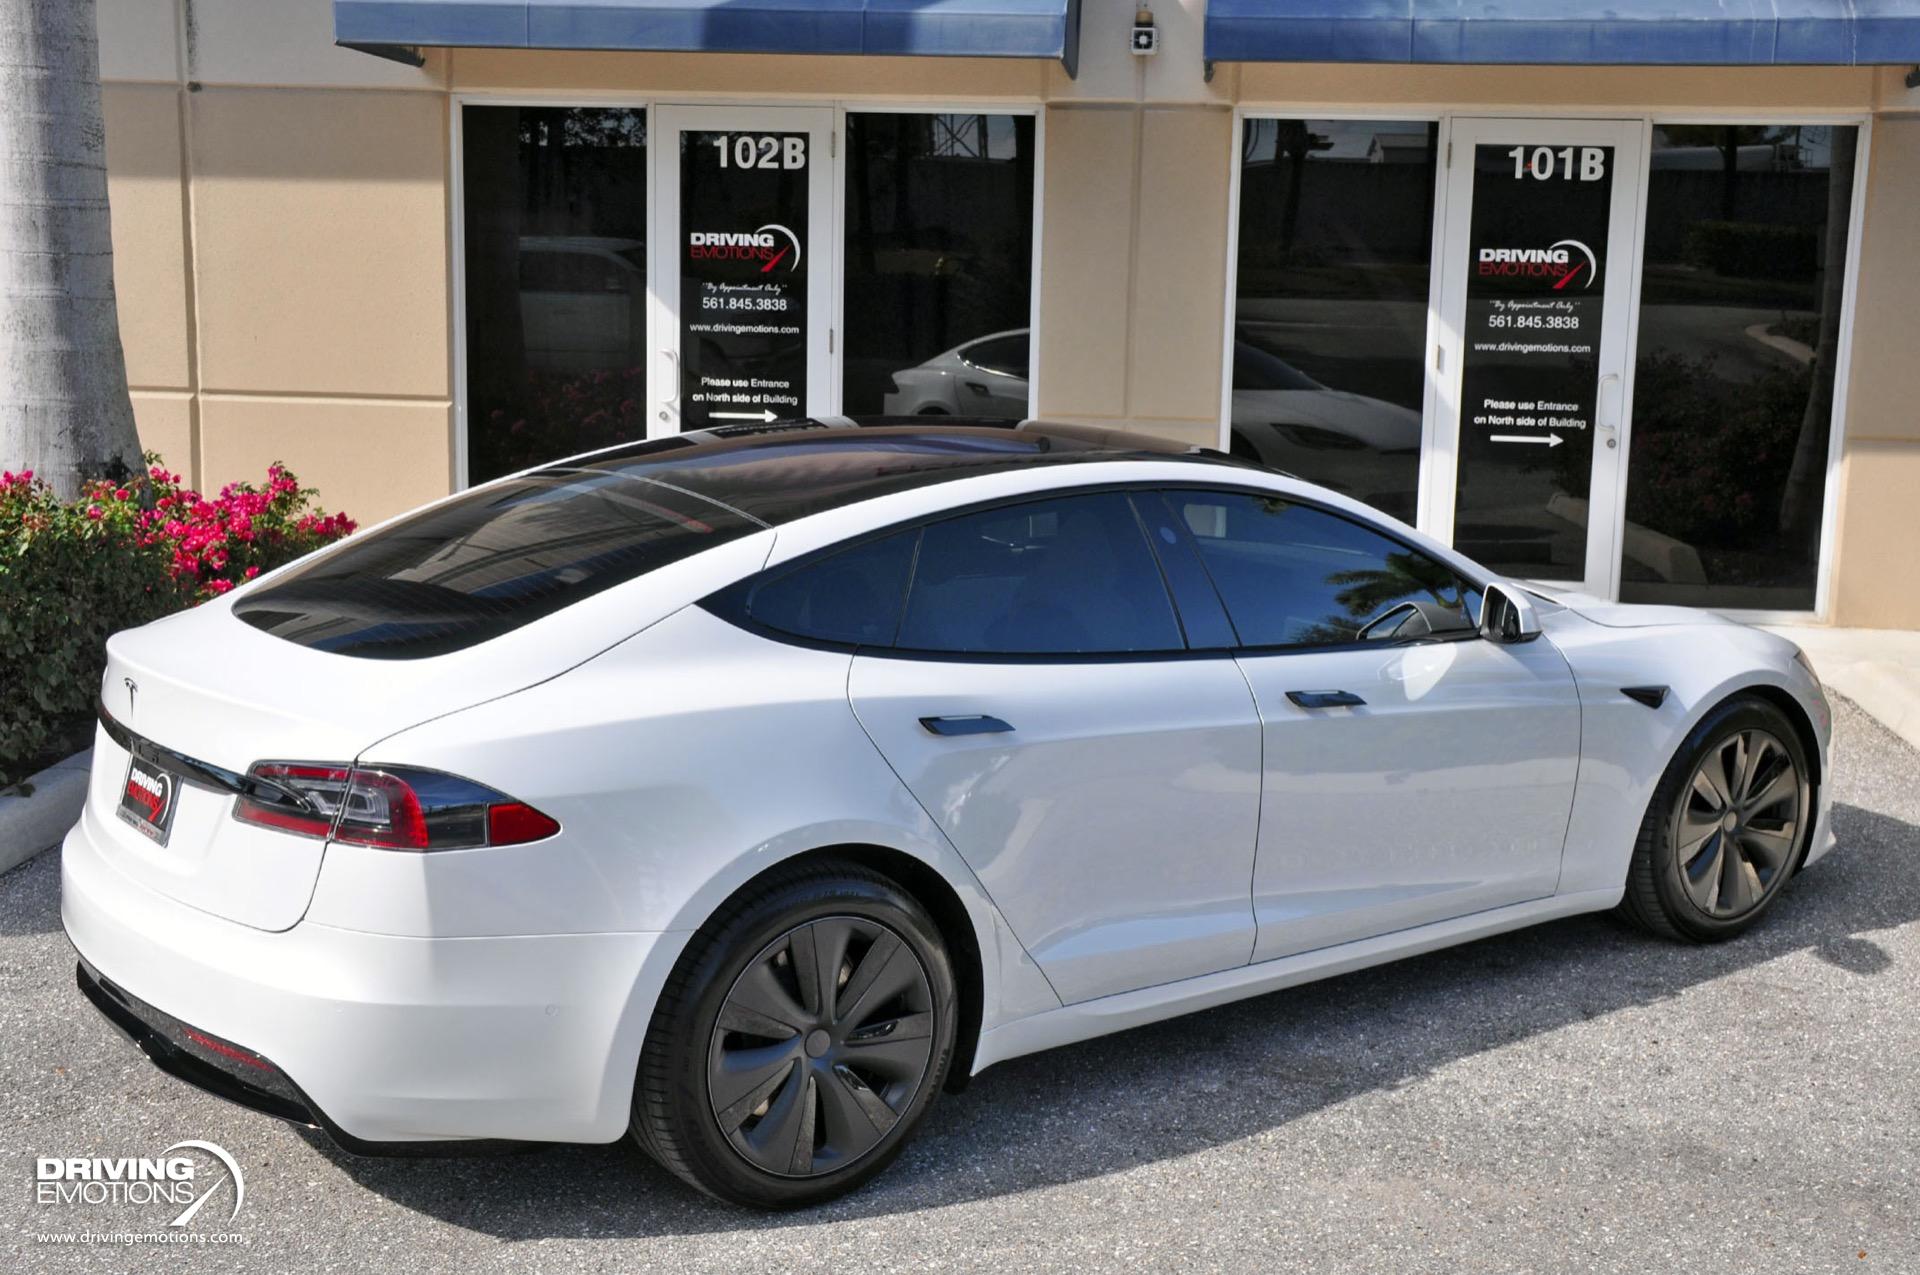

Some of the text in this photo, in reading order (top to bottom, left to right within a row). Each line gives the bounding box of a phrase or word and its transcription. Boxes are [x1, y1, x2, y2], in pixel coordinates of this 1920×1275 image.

[713, 135, 805, 170] 102B
[1508, 146, 1605, 181] 101B
[690, 233, 774, 247] DRIVING
[690, 246, 774, 260] EMOTIONS
[1480, 249, 1568, 263] DRIVING
[1479, 262, 1568, 276] EMOTIONS
[702, 297, 787, 311] 561.845.3838
[690, 323, 800, 334] www.drivingemotions.com
[1488, 315, 1580, 329] 561.845.3838
[1474, 342, 1591, 354] www.drivingemotions.com
[701, 377, 731, 387] Please
[750, 379, 790, 389] Entrance
[692, 393, 798, 406] on North side of Building
[1484, 399, 1579, 411] Please use Entrance
[1473, 415, 1587, 430] on North side of Building
[131, 768, 163, 797] DRIVING
